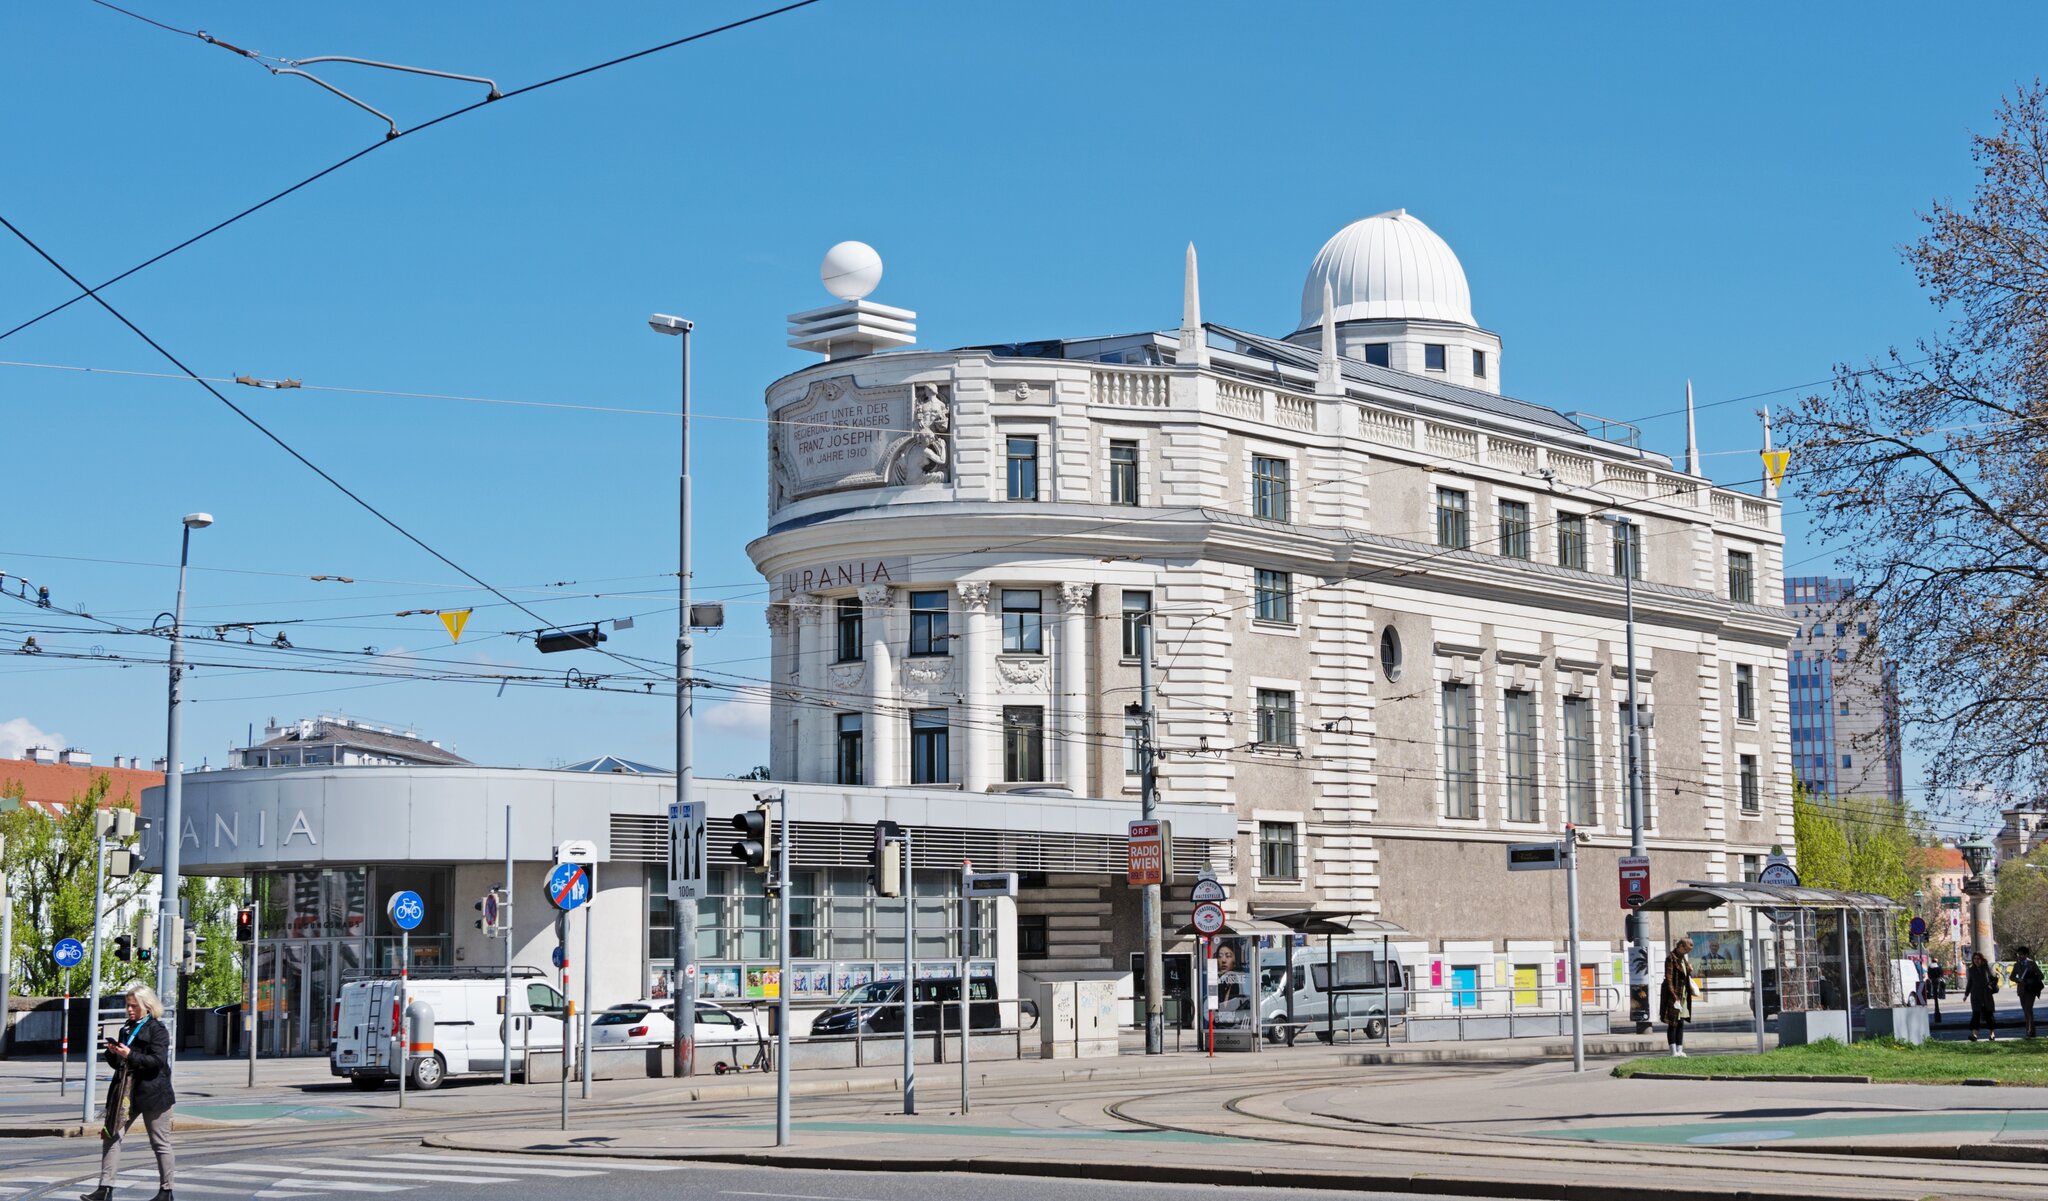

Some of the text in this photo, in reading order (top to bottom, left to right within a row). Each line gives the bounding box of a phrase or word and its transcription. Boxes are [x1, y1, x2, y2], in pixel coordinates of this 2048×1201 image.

[831, 405, 863, 420] UNTER
[867, 402, 888, 415] DER
[832, 420, 848, 431] DES
[852, 414, 890, 428] KAISERS
[798, 437, 824, 455] FRANZ
[827, 430, 872, 448] JOSEPH
[806, 447, 867, 466] IM JAHRE 1910
[789, 560, 891, 593] URANIA
[1132, 827, 1149, 835] ORF
[1130, 845, 1159, 857] RADIO
[1131, 856, 1159, 870] WIEN
[1767, 867, 1789, 876] AUTOBUS
[678, 885, 695, 897] 100m
[1199, 881, 1217, 891] AUTOBUS
[1196, 905, 1221, 917] STRASSENBAHN
[1197, 921, 1220, 931] HALTESTELLE
